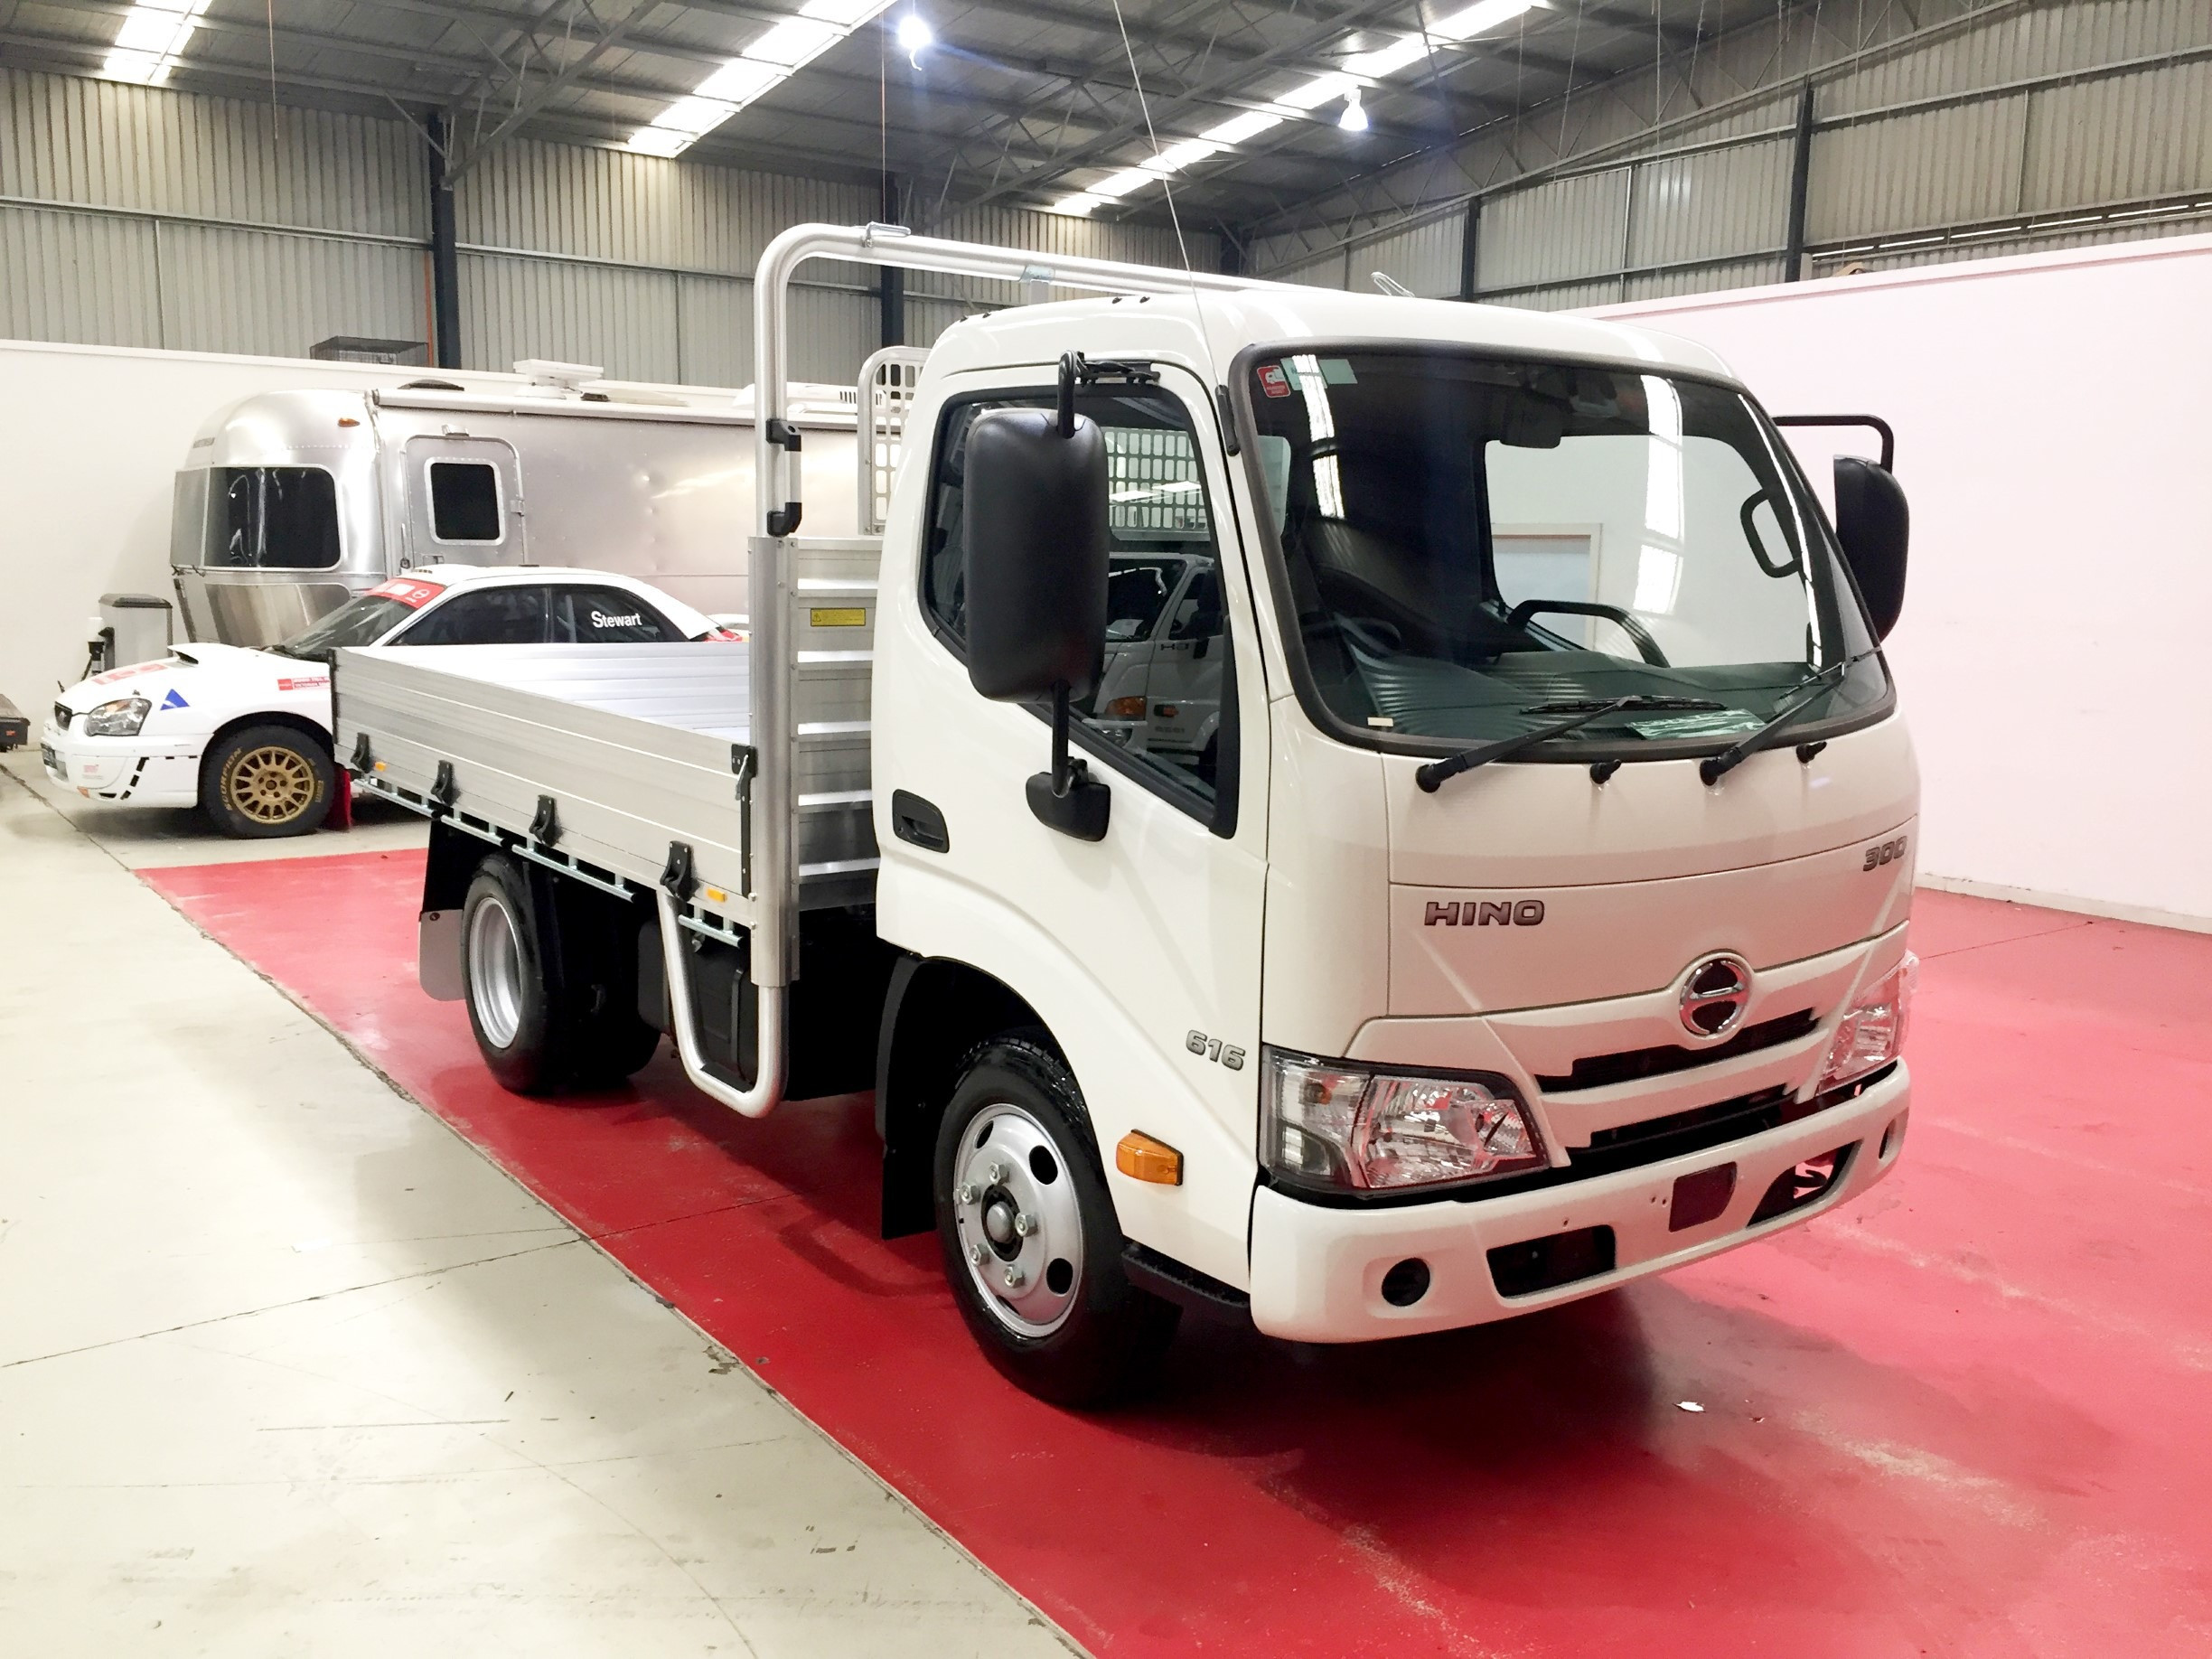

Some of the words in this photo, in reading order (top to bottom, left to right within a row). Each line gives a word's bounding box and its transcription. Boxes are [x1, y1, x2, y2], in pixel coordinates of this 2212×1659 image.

[591, 610, 642, 628] Stewart
[1862, 835, 1907, 872] 300
[1424, 900, 1545, 926] HINO
[1186, 1029, 1246, 1072] 616
